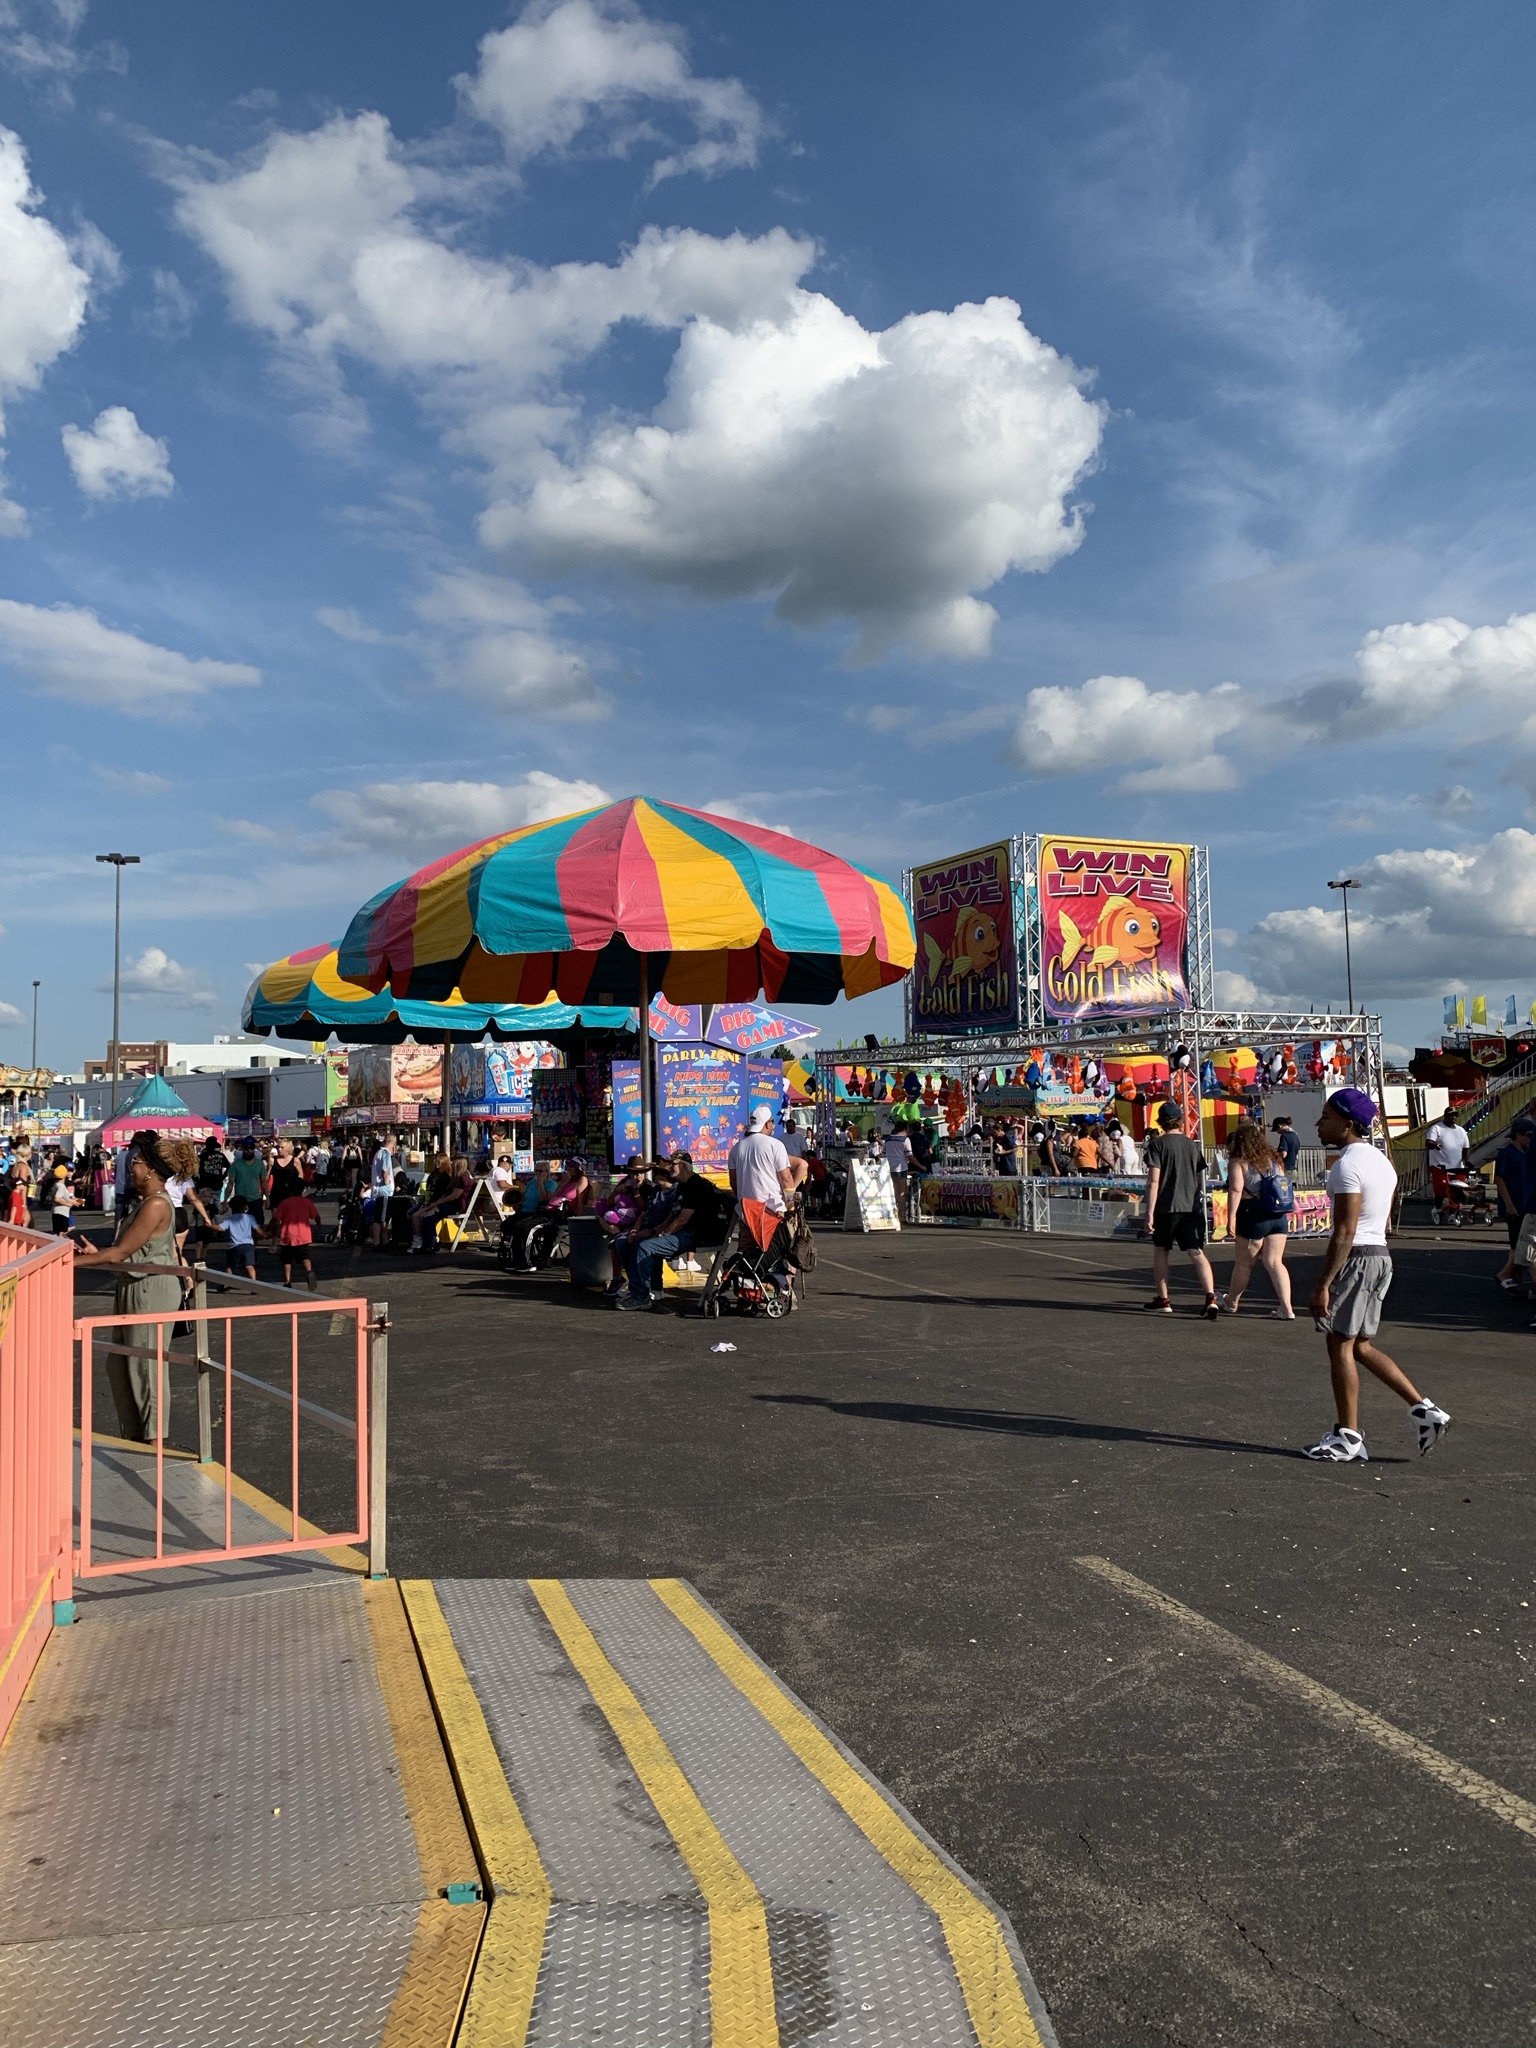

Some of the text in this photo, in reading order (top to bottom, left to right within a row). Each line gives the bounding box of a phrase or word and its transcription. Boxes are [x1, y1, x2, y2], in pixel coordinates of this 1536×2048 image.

[918, 855, 997, 895] WIN
[1052, 847, 1172, 876] WIN
[916, 880, 1003, 920] LIVE
[1047, 872, 1174, 902] LIVE
[918, 970, 1009, 1016] Gold Fish
[1048, 954, 1176, 1004] Gold Fish
[656, 996, 691, 1027] BIG
[720, 1008, 756, 1034] BIG
[736, 1019, 787, 1049] GAME
[423, 1047, 444, 1055] SAUSA
[662, 1049, 706, 1065] PARTY
[673, 1070, 730, 1082] KIDS WIN
[500, 1105, 526, 1113] PRETZELS
[1045, 1096, 1063, 1104] LIVE
[942, 1182, 992, 1197] WIN LIVE
